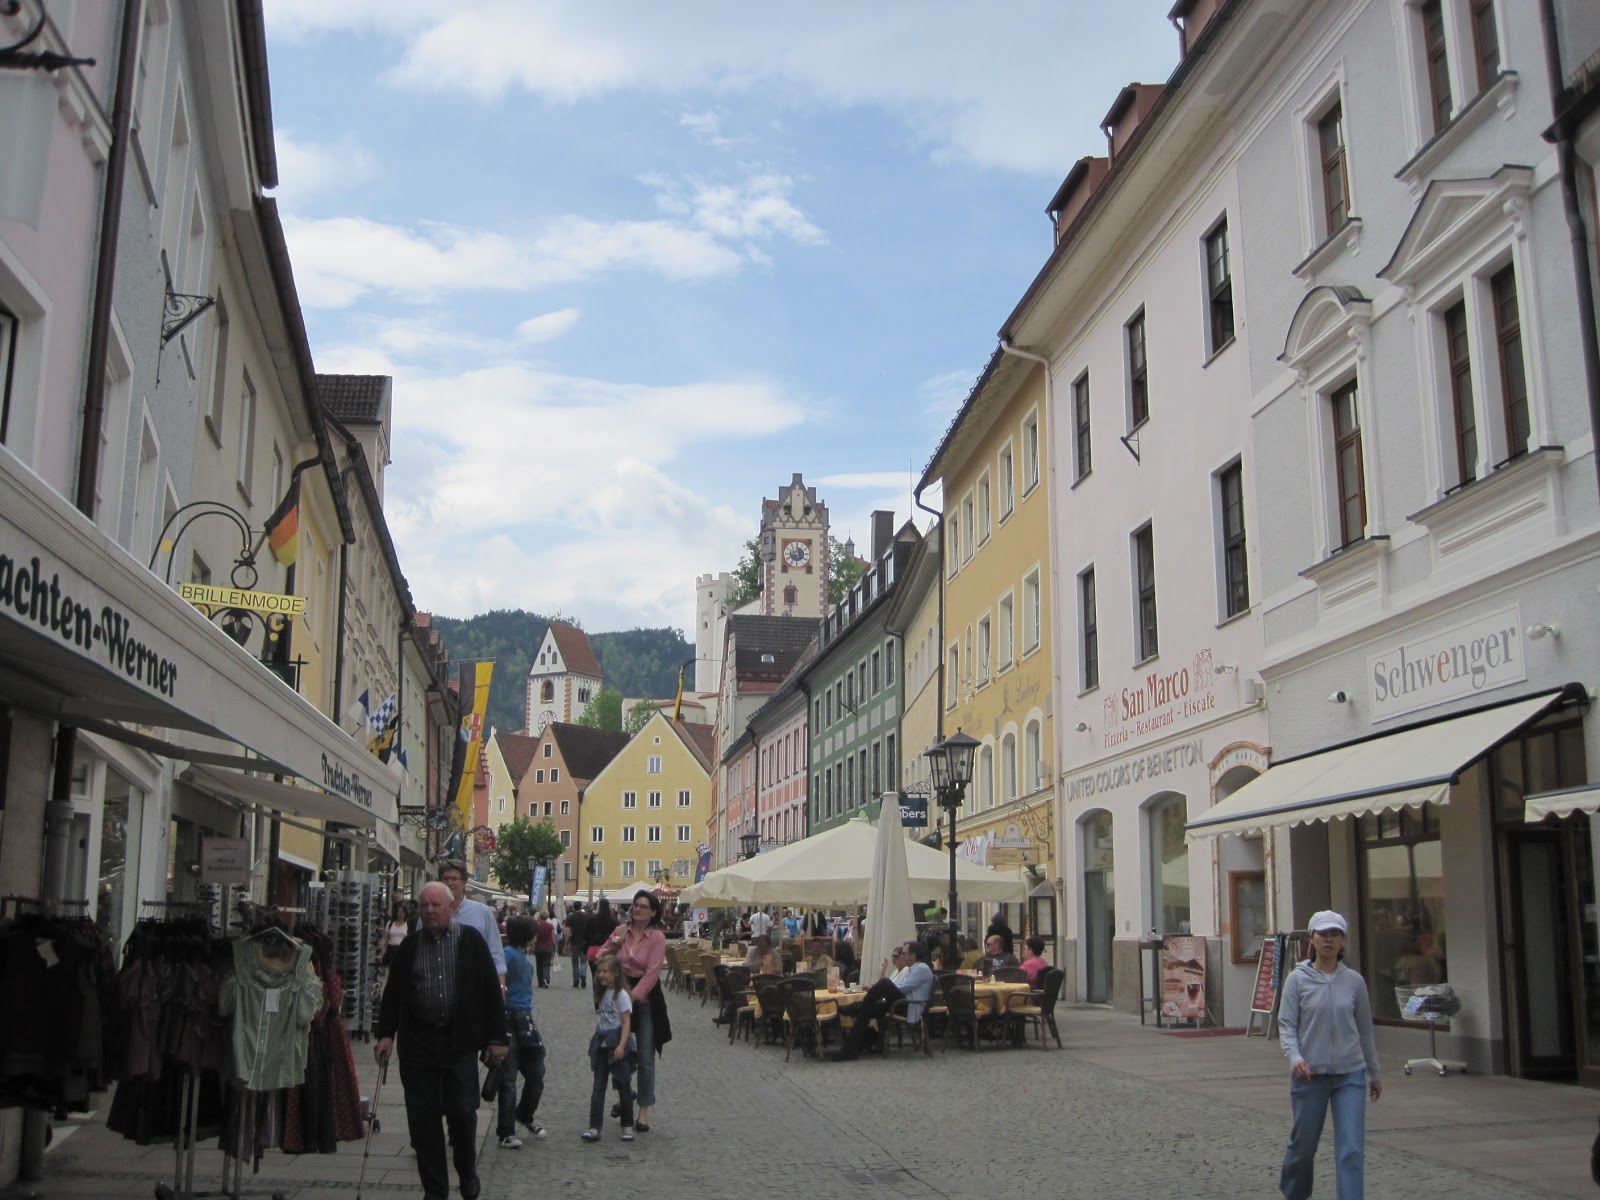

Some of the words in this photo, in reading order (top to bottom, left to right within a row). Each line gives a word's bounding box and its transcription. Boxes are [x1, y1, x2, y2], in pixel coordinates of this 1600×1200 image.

[181, 585, 304, 613] BRILLENMODE
[1374, 626, 1516, 703] Schwenger
[1121, 687, 1145, 721] San
[1146, 667, 1189, 712] Marco
[1104, 725, 1128, 749] Pizzeria
[1136, 706, 1174, 737] Restaurant
[1066, 775, 1096, 802] UNITED
[1095, 762, 1131, 793] COLORS
[1131, 757, 1146, 783] OF
[1147, 737, 1204, 779] BENETTON
